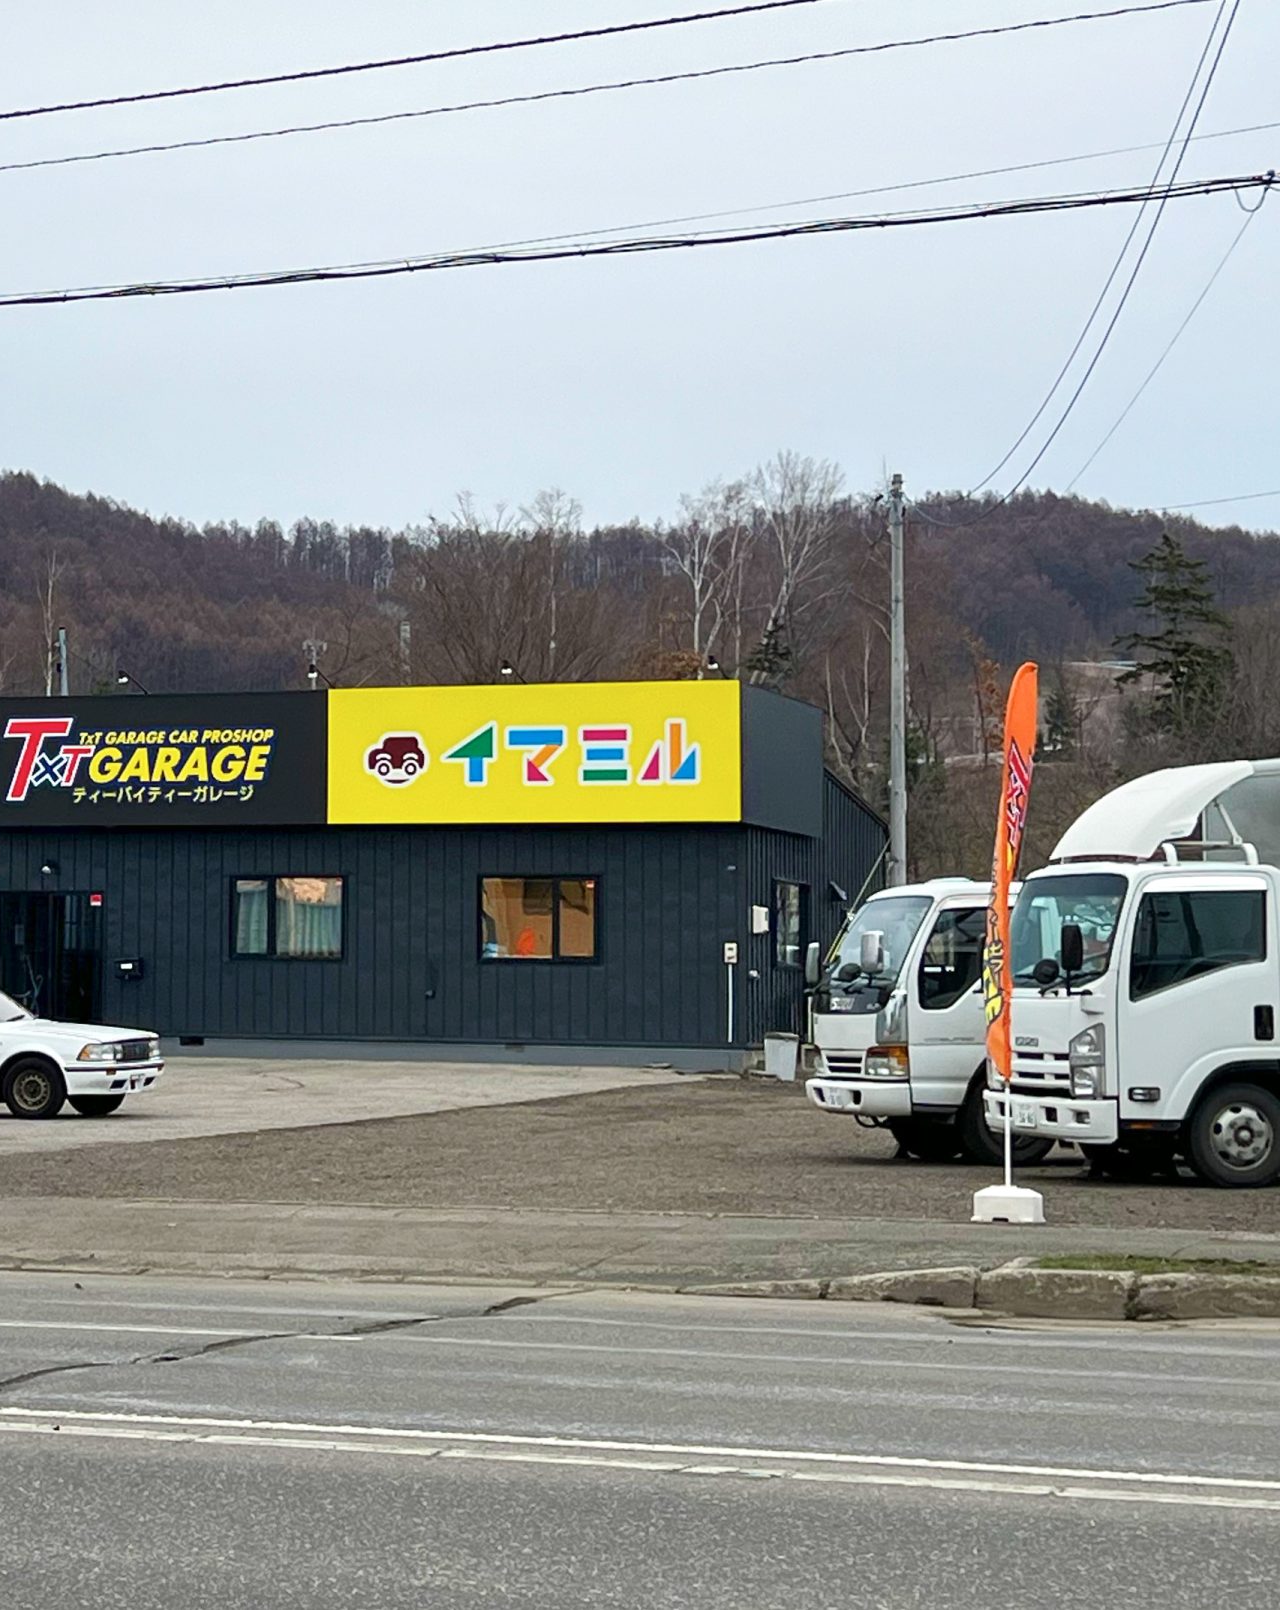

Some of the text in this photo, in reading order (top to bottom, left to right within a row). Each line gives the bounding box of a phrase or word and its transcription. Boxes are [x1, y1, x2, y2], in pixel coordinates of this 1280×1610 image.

[105, 731, 166, 745] GARAGE
[168, 730, 200, 744] CAR
[201, 728, 275, 744] PROSHOP
[88, 745, 271, 784] GARAGE
[441, 718, 700, 786] イマミル
[72, 785, 255, 804] ティーバイティーガレージ
